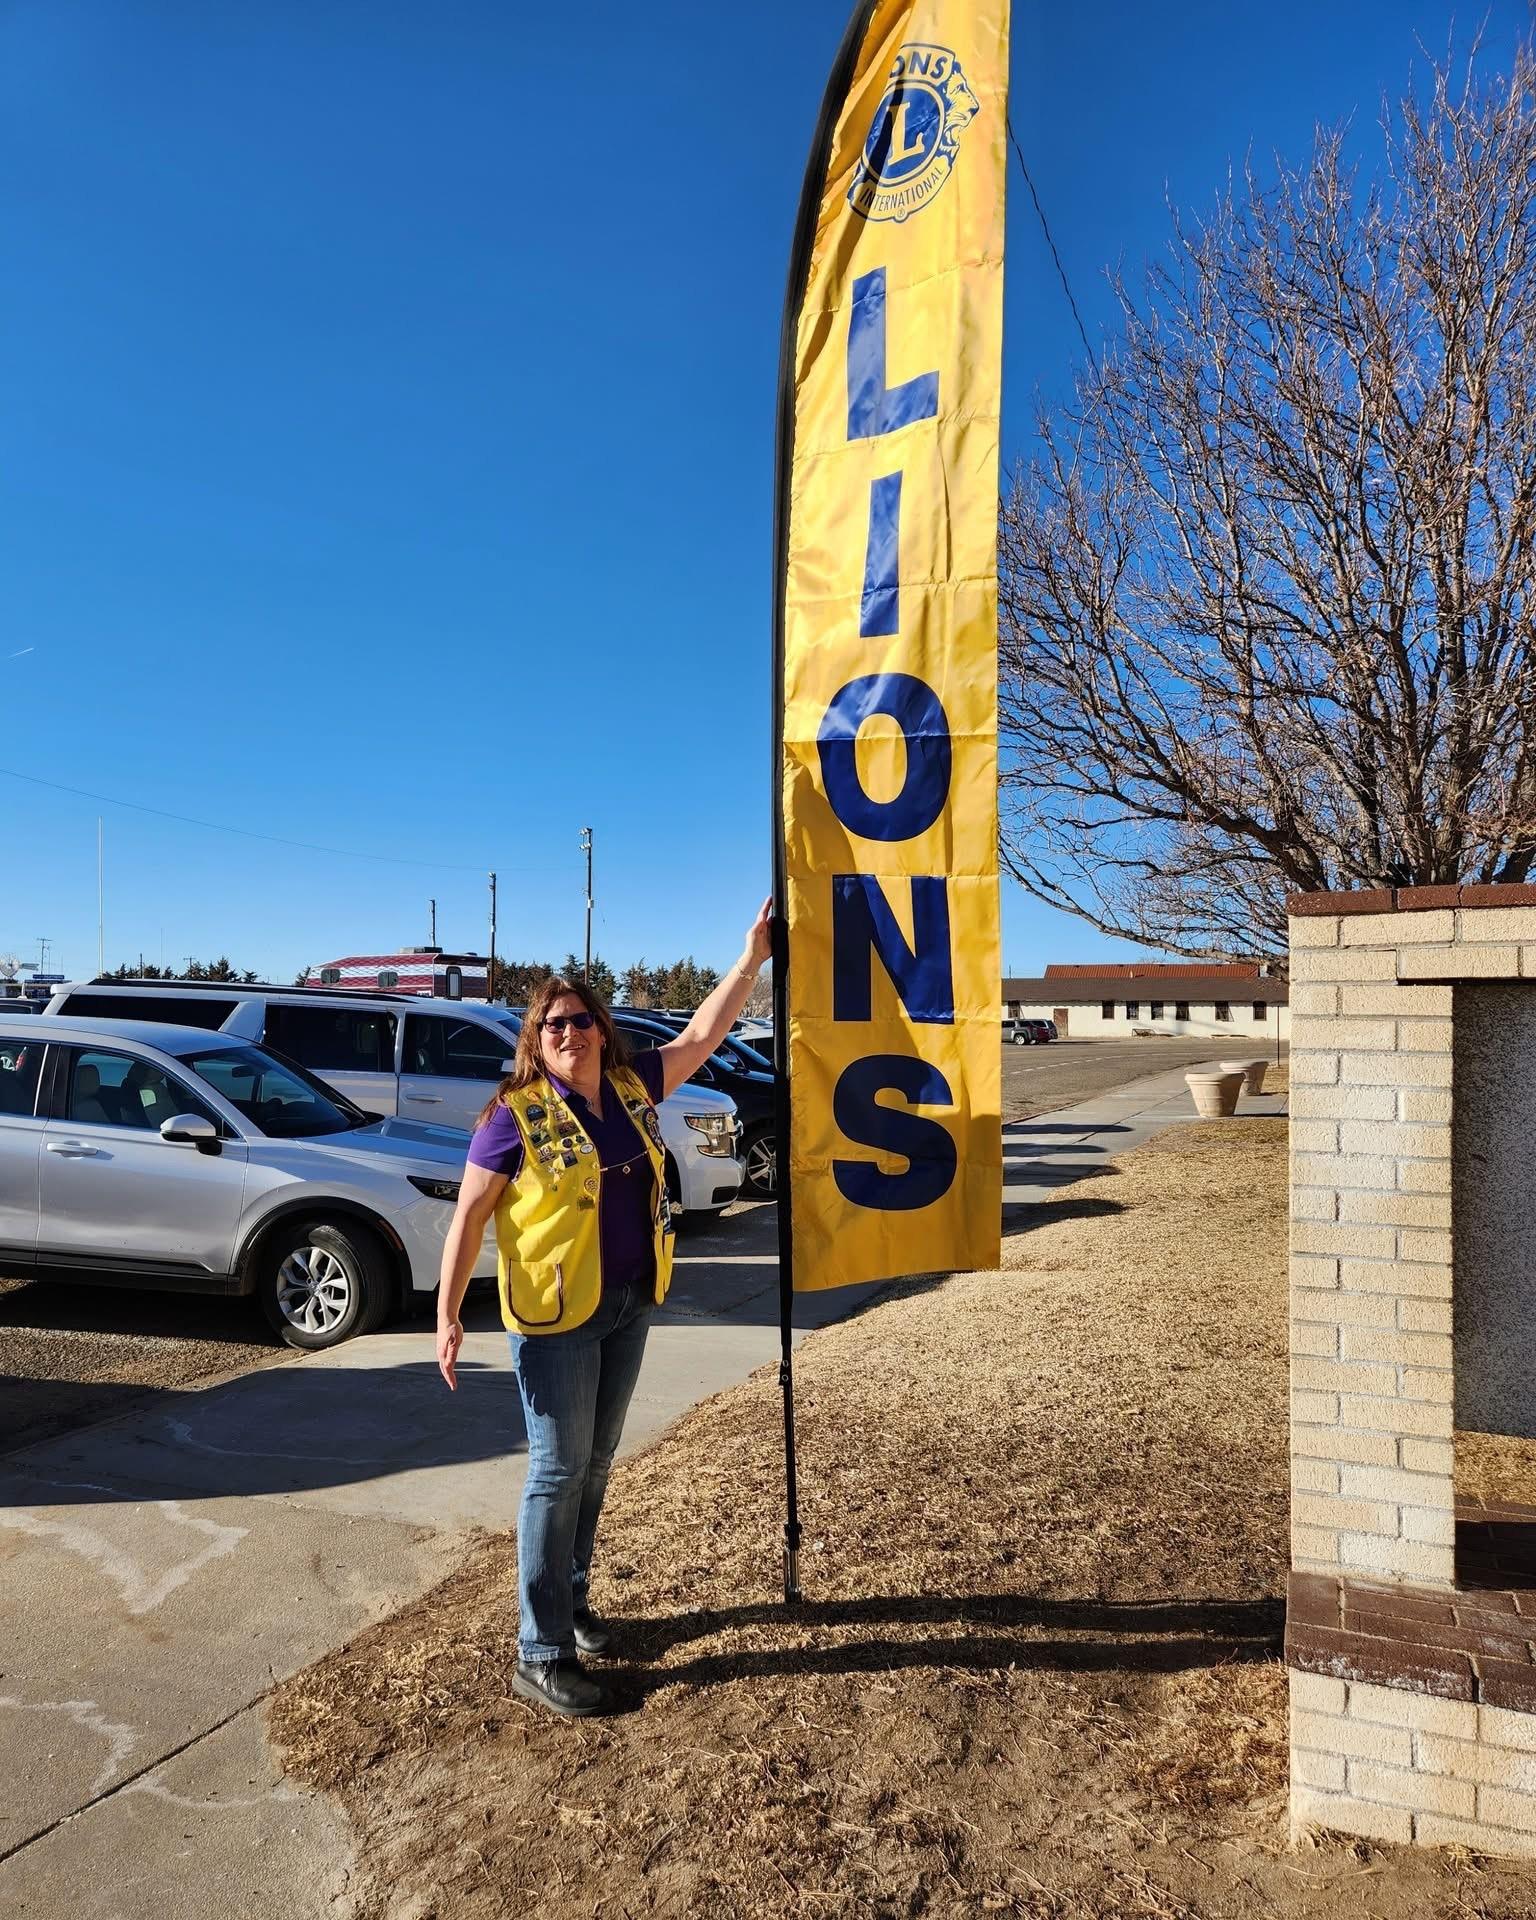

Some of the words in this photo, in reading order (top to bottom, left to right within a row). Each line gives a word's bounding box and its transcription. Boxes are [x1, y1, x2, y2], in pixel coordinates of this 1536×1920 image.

[886, 102, 925, 166] L
[859, 167, 944, 212] INTERNATIONAL
[817, 265, 958, 1212] LIONS
